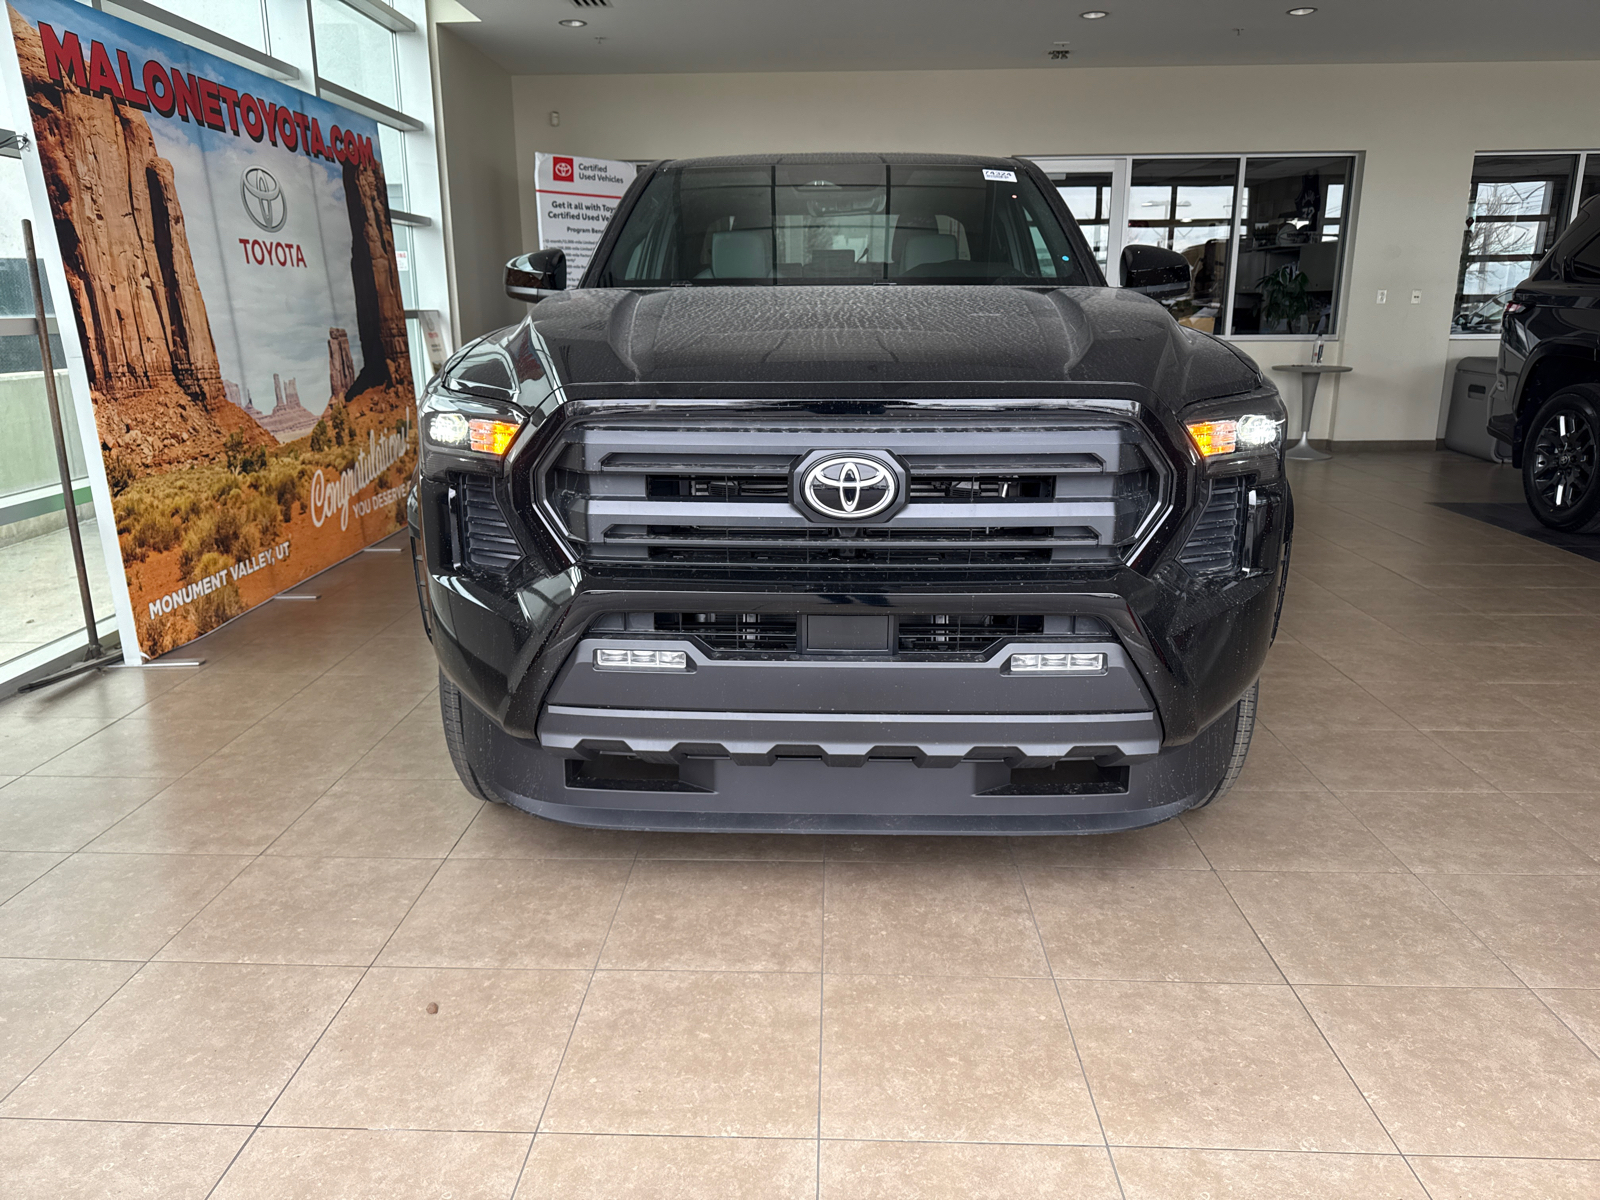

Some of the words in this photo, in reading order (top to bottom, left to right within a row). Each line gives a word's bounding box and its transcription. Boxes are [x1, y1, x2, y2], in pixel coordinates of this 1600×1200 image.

[37, 20, 377, 171] MALONETOYOTA.COM
[578, 163, 608, 173] Certified
[578, 172, 596, 181] Used
[597, 174, 624, 184] Vehicles
[548, 211, 581, 220] Certified
[582, 212, 600, 221] Used
[601, 213, 612, 222] Ve
[551, 201, 566, 210] Get
[567, 201, 573, 210] it
[574, 202, 584, 210] all
[585, 203, 601, 212] with
[567, 226, 591, 234] Program
[238, 238, 308, 268] TOYOTA
[311, 406, 410, 532] Congratulations!
[352, 496, 371, 519] YOU
[372, 483, 407, 511] DESERVE
[148, 569, 228, 620] MONUMENT
[230, 549, 275, 581] VALLEY,
[275, 541, 290, 560] UT
